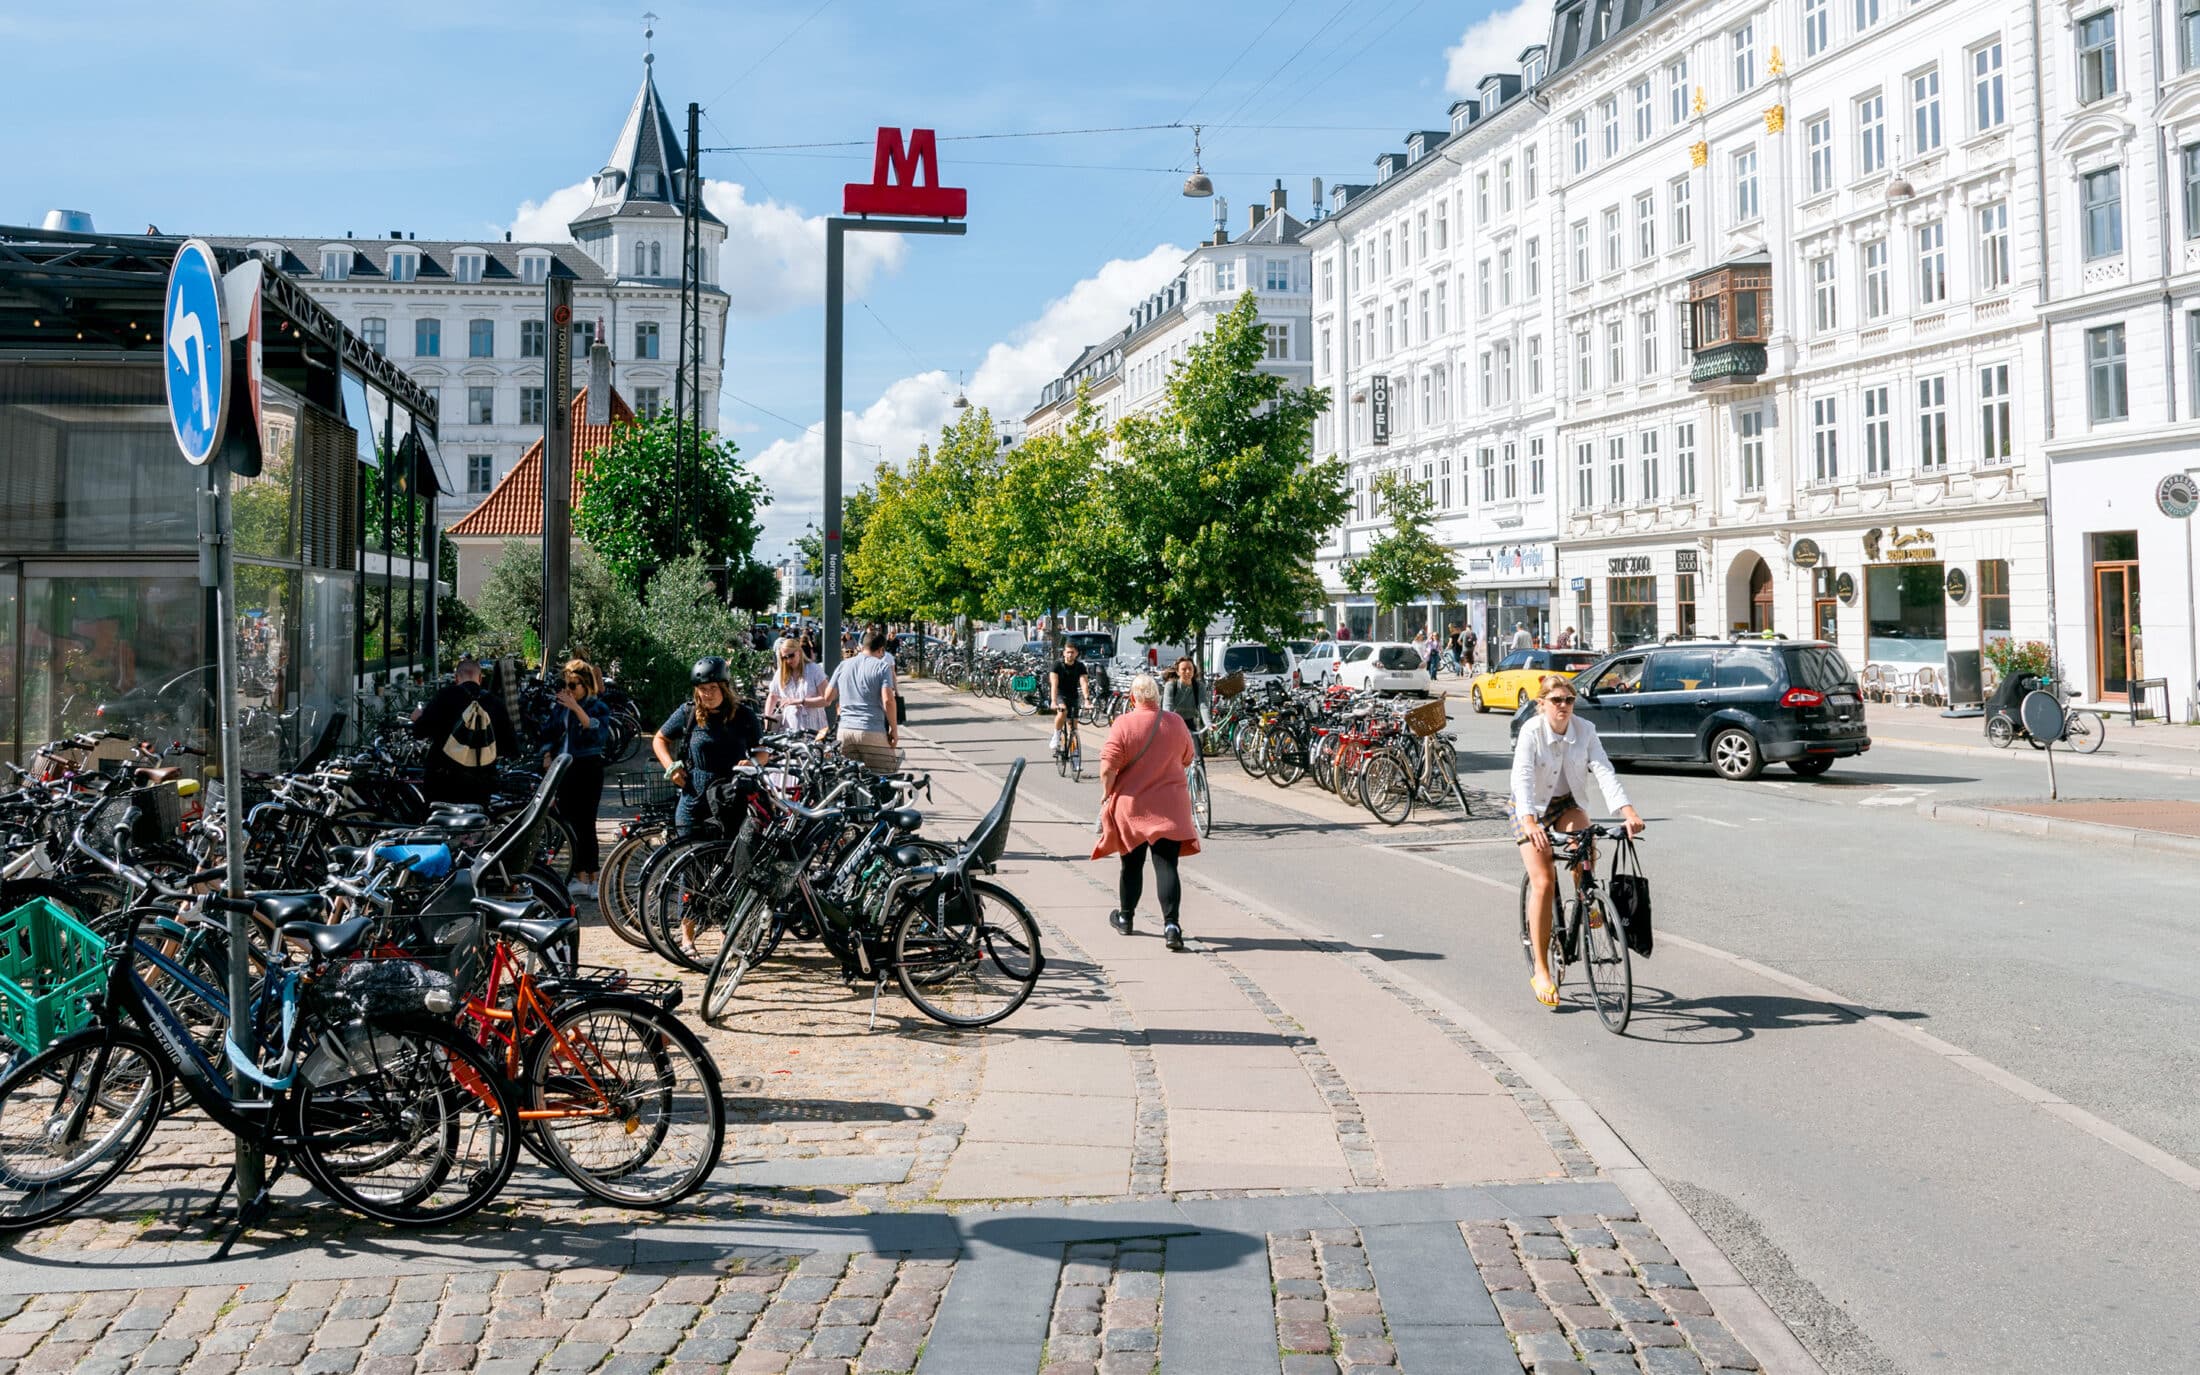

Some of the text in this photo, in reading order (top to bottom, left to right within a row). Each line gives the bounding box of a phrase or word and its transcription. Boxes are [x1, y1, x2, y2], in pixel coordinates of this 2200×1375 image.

[558, 327, 567, 409] TORVEHALLERNE
[1374, 378, 1386, 436] HOTEL
[2162, 475, 2197, 493] ESPRESSO
[1678, 552, 1696, 561] STOF
[1678, 561, 1697, 570] 2000
[148, 1021, 182, 1065] Gazelle
